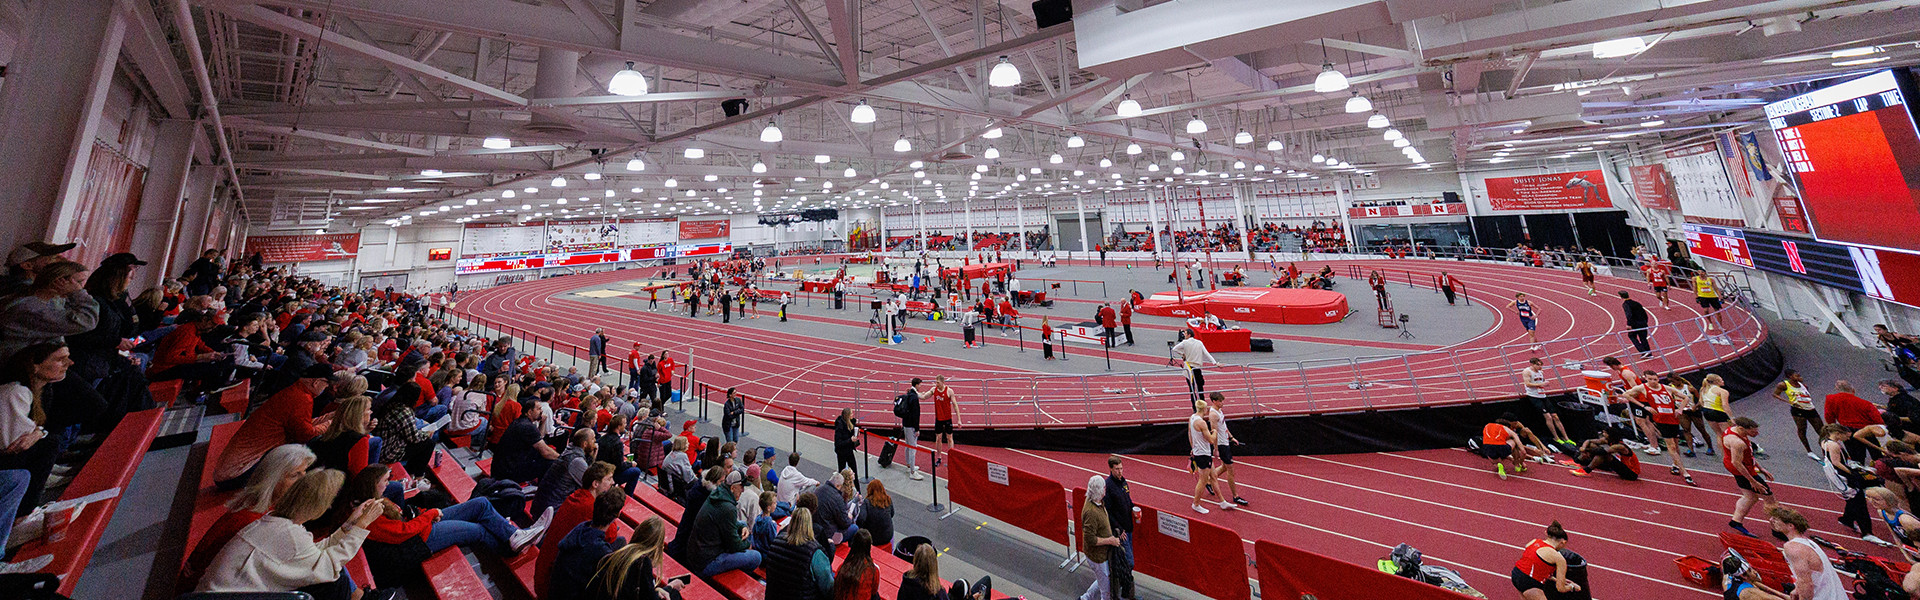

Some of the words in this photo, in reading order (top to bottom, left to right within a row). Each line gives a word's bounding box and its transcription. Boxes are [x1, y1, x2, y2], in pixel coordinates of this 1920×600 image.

[1854, 97, 1868, 113] LAP
[1879, 89, 1903, 107] TIME
[1434, 205, 1445, 213] N
[619, 249, 631, 261] N
[1781, 240, 1807, 274] N
[1847, 246, 1895, 300] N
[1651, 394, 1672, 404] N
